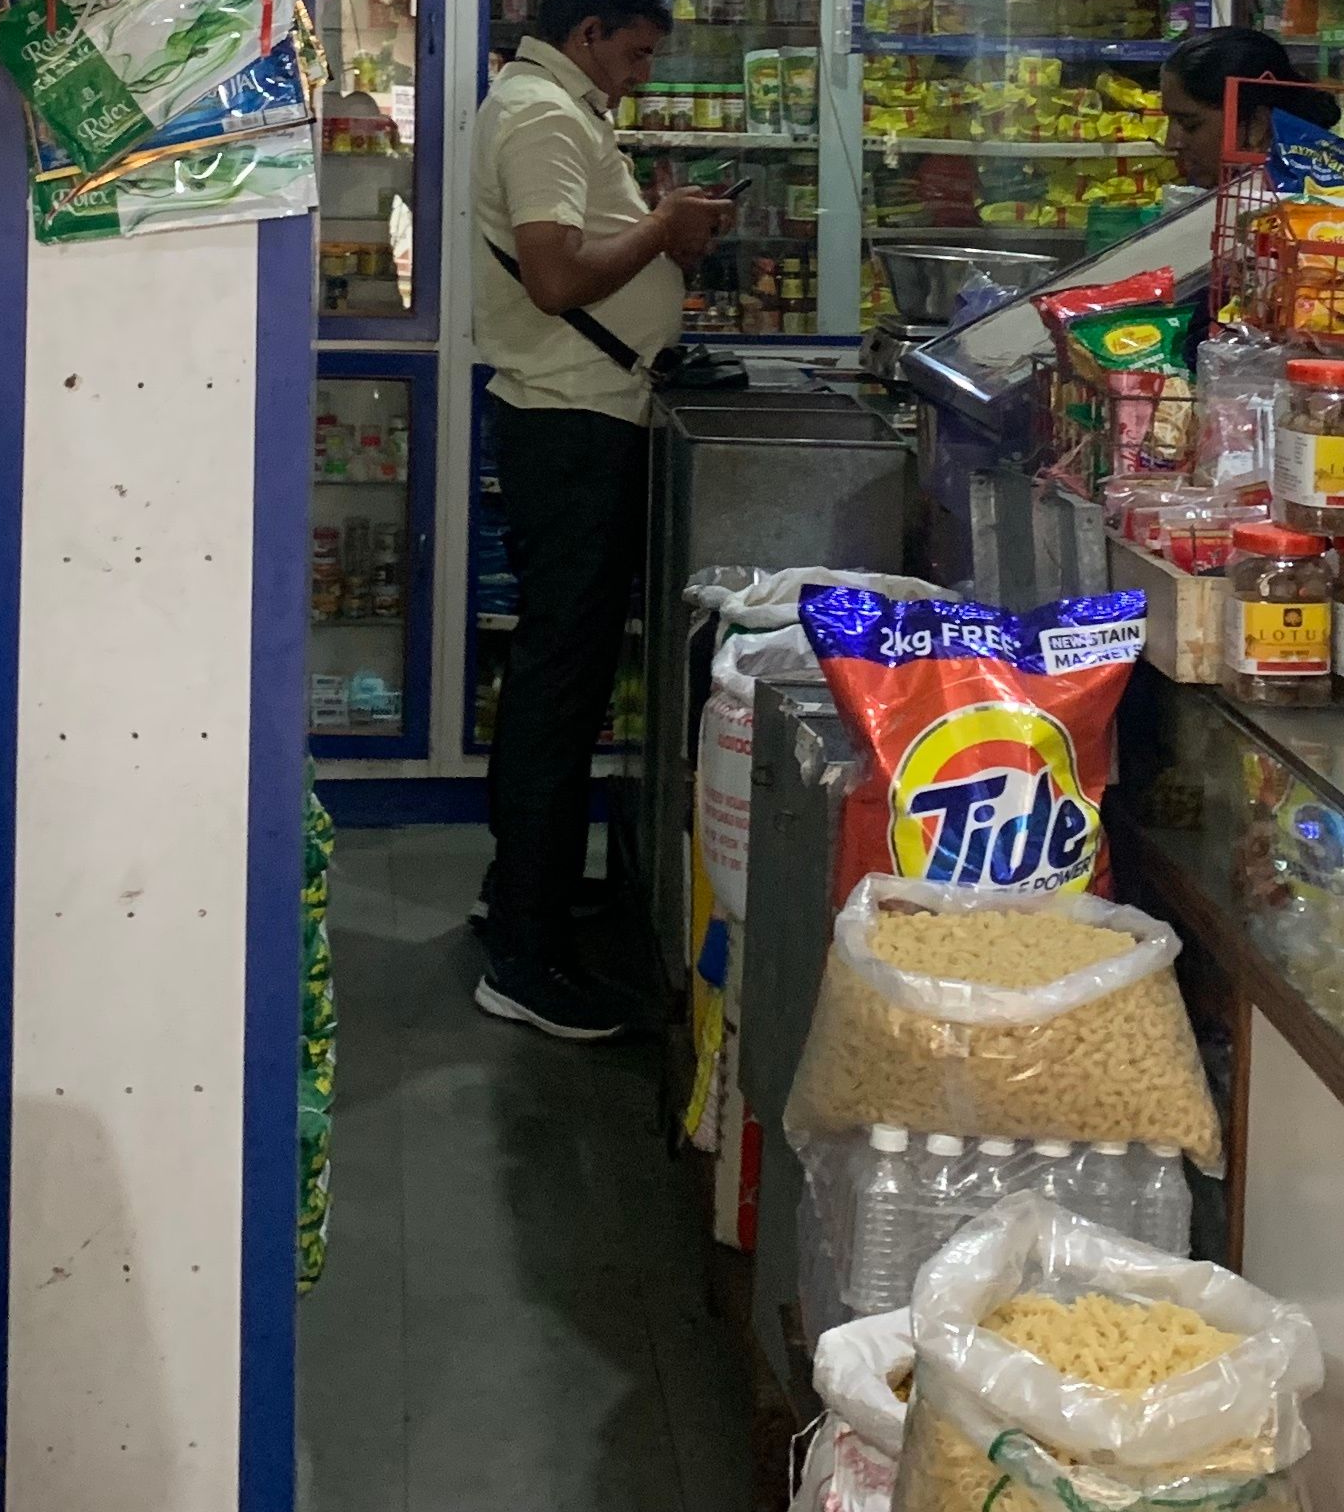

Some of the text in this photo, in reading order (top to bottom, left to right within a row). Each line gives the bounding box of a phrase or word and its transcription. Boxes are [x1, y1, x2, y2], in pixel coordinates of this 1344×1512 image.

[22, 20, 75, 63] Rolex
[76, 94, 132, 142] Rolex
[878, 625, 933, 659] 2kg
[1084, 625, 1141, 648] STAIN
[910, 767, 1093, 889] Tide
[1032, 854, 1093, 891] POWER
